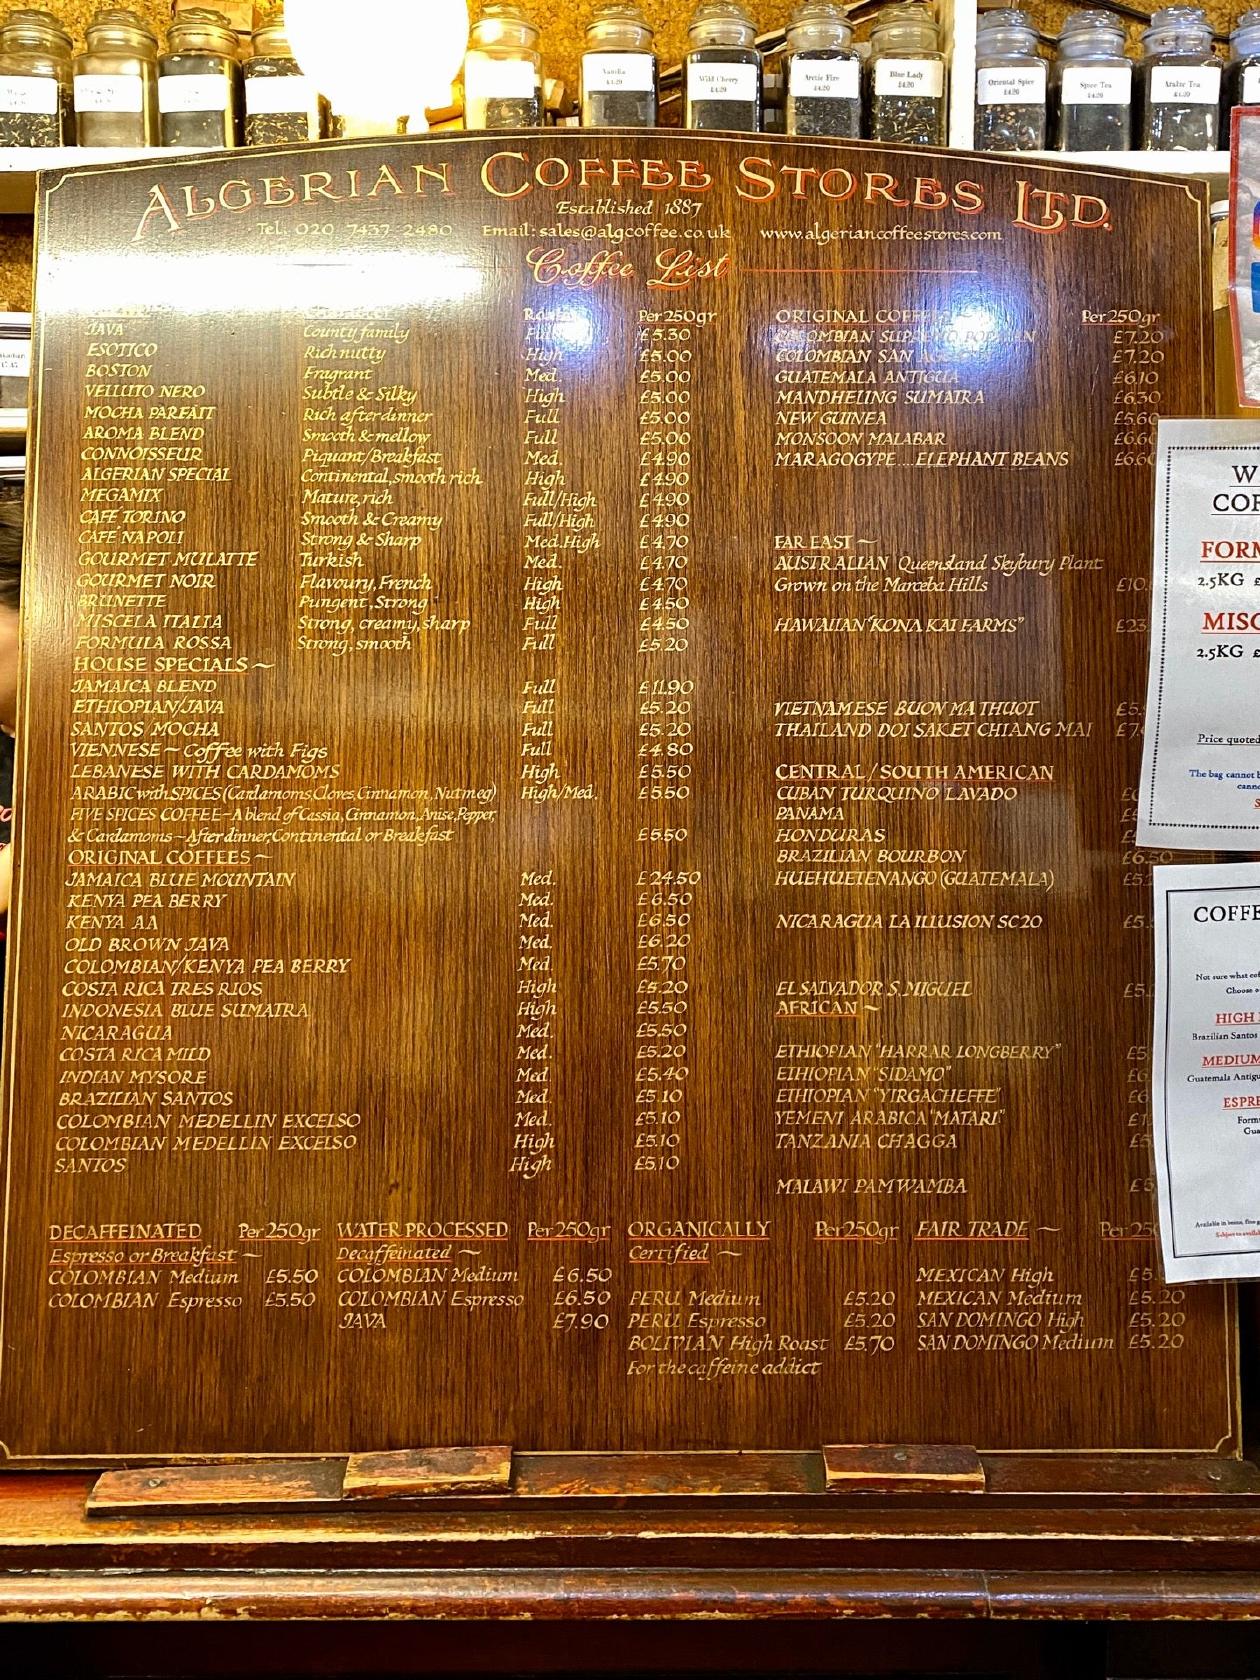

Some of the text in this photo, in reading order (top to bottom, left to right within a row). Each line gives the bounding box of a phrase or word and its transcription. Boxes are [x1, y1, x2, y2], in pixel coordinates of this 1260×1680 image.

[130, 162, 455, 244] ALGERIAN
[481, 152, 714, 200] COFFEE
[735, 157, 986, 215] STORES
[556, 199, 702, 218] Established 1887
[257, 223, 452, 239] Tel. 020 7437 2480
[760, 222, 1002, 246] www.algeriancoffeestores.com
[526, 246, 730, 291] Coffee List
[776, 309, 869, 324] ORIGINAL
[1113, 330, 1163, 344] £7.20
[86, 343, 158, 357] ESOTICO
[639, 350, 692, 363] £5.00
[85, 365, 152, 377] BOSTON
[303, 367, 372, 386] Fragrant
[524, 368, 563, 383] Med.
[639, 371, 692, 384] £5.00
[775, 371, 959, 384] GUATEMALA ANTIGUA
[84, 385, 205, 398] VELLUTO NERO
[525, 388, 565, 404] High
[775, 391, 984, 405] MANDHELING SUMATRA
[83, 406, 217, 420] MOCHA PARFAIT
[524, 410, 560, 424] Full
[775, 412, 887, 426] NEW GUINEA
[82, 427, 204, 440] AROMA BLEND
[775, 432, 946, 446] MONSOON MALABAR
[80, 447, 203, 460] CONNOISSEUR
[81, 468, 233, 481] ALGERIAN SPECIAL
[80, 489, 164, 502] MEGAMIX
[523, 492, 598, 510] Full/High
[774, 536, 852, 549] FAR EAST
[78, 552, 259, 567] GOURMET MULATTE
[299, 553, 364, 568] Turkish
[774, 554, 1103, 576] AUSTRALIAN Queensland Skybury Plant
[1198, 573, 1244, 589] 2.5KG
[75, 636, 232, 650] FORMULA ROSSA
[73, 657, 248, 671] HOUSE SPECIALS
[522, 680, 556, 694] Full
[639, 723, 691, 736] £5.20
[775, 722, 1093, 737] THAILAND DOI SAKET CHIANG MAI
[1198, 734, 1223, 743] Price
[70, 765, 339, 779] LEBANESE WITH CARDAMOMS
[1189, 770, 1254, 780] The bag cannot
[776, 786, 1018, 801] CUBAN TURQUINO LAVADO
[775, 807, 844, 821] PANAMA
[68, 850, 250, 865] ORIGINAL COFFEES
[776, 850, 967, 864] BRAZILIAN BOURBON
[65, 872, 295, 888] JAMAICA BLUE MOUNTAIN
[520, 872, 556, 886] Med.
[65, 916, 158, 930] KENYA AA
[65, 937, 229, 951] OLD BROWN JAVA
[637, 956, 686, 974] £5.70
[62, 1003, 309, 1018] INDONESIA BLUE SUMATRA
[517, 1001, 557, 1020] High
[637, 1001, 687, 1014] £5.50
[776, 1000, 857, 1015] AFRICAN
[1216, 1012, 1255, 1023] HIGH
[1231, 1032, 1258, 1040] Santos
[59, 1070, 207, 1084] INDIAN MYSORE
[1187, 1075, 1230, 1083] Guatemala
[57, 1113, 361, 1129] COLOMBIAN MEDELLIN EXCELSO
[515, 1112, 552, 1127] Med.
[635, 1134, 679, 1147] £5.10
[775, 1134, 958, 1149] TANZANIA CHAGGA
[49, 1223, 202, 1240] DECAFFEINATED
[337, 1222, 508, 1237] WATER PROCESSED
[627, 1221, 769, 1237] ORGANICALLY
[916, 1221, 1029, 1237] FAIR TRADE
[49, 1245, 237, 1266] Espresso or Breakfast
[336, 1244, 452, 1265] Decaffeinated
[629, 1244, 709, 1264] Certified
[49, 1269, 239, 1285] COLOMBIAN Medium
[265, 1269, 318, 1284] £5.50
[916, 1267, 1054, 1287] MEXICAN High
[553, 1291, 611, 1306] £6.50
[552, 1314, 609, 1332] £7.90
[627, 1313, 766, 1332] PERU Espresso
[844, 1314, 895, 1328] £5.20
[917, 1312, 1084, 1332] SAN DOMINGO High
[1129, 1312, 1185, 1327] £5.20
[628, 1335, 829, 1356] BOLIVIAN High Roast
